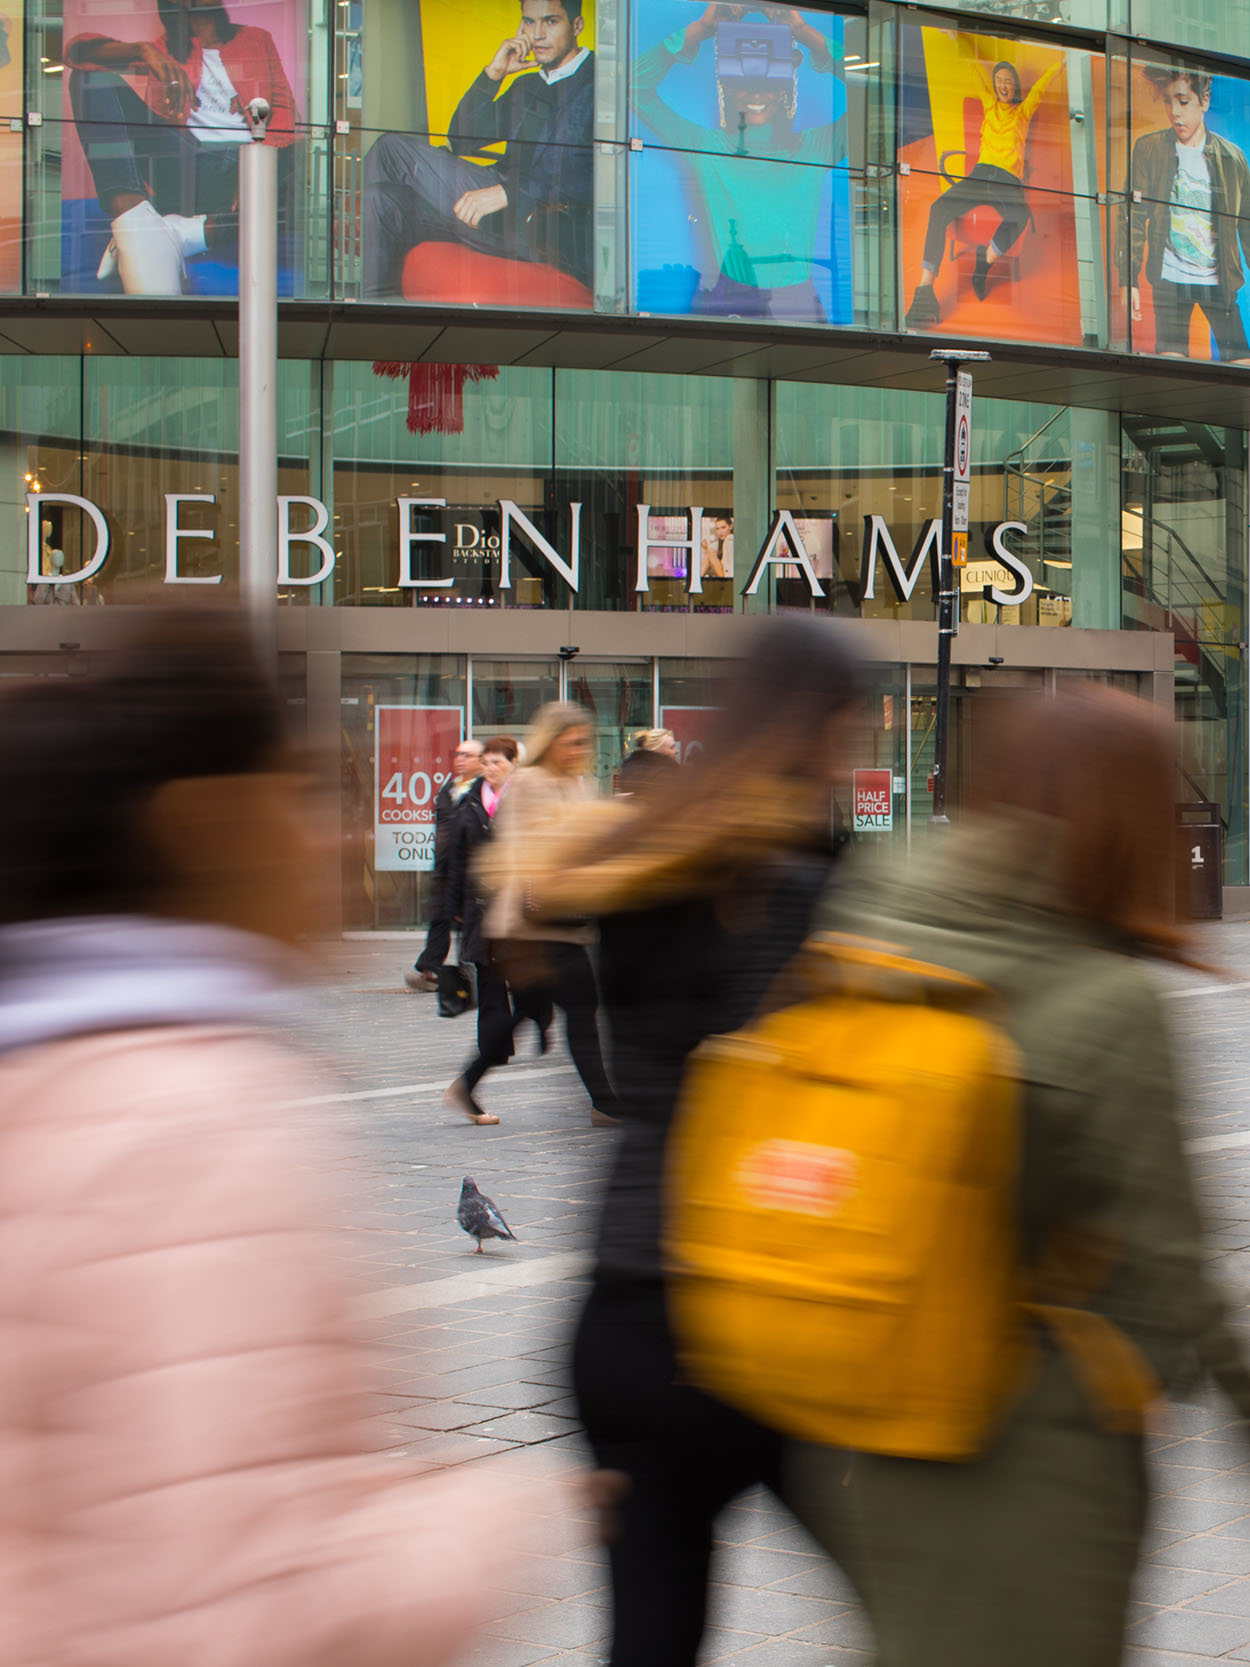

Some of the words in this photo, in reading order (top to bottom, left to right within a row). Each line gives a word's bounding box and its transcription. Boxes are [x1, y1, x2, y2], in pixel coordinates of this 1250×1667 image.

[453, 523, 501, 549] Dio
[24, 493, 1034, 606] DEBENHAMS
[452, 549, 502, 558] BACKSTA
[966, 569, 1015, 584] CLINIQU
[856, 790, 886, 802] HALF
[856, 802, 888, 813] PRICE
[382, 809, 437, 822] COOKSH
[856, 814, 890, 827] SALE
[392, 831, 437, 845] TODA
[1191, 846, 1204, 863] 1
